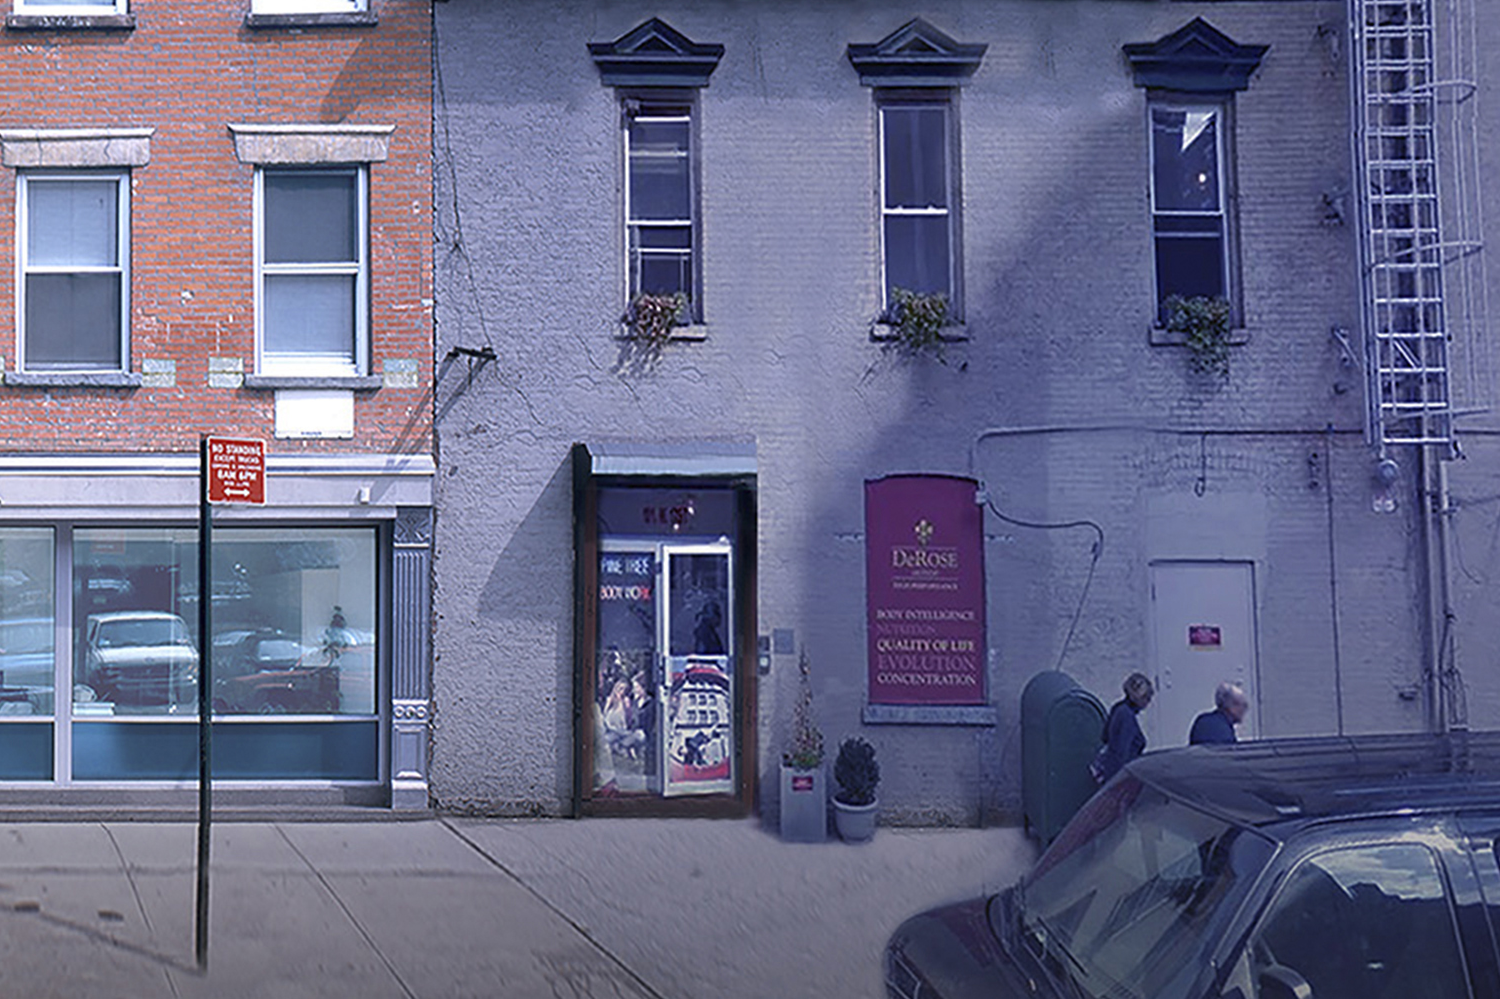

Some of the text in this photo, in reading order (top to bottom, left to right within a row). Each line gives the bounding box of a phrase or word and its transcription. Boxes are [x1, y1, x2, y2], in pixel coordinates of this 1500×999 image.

[226, 444, 261, 456] STANDING
[877, 639, 975, 653] QUALITY OF LIFE
[878, 654, 976, 671] EVOLUTION
[877, 672, 977, 686] CONCENTRATION
